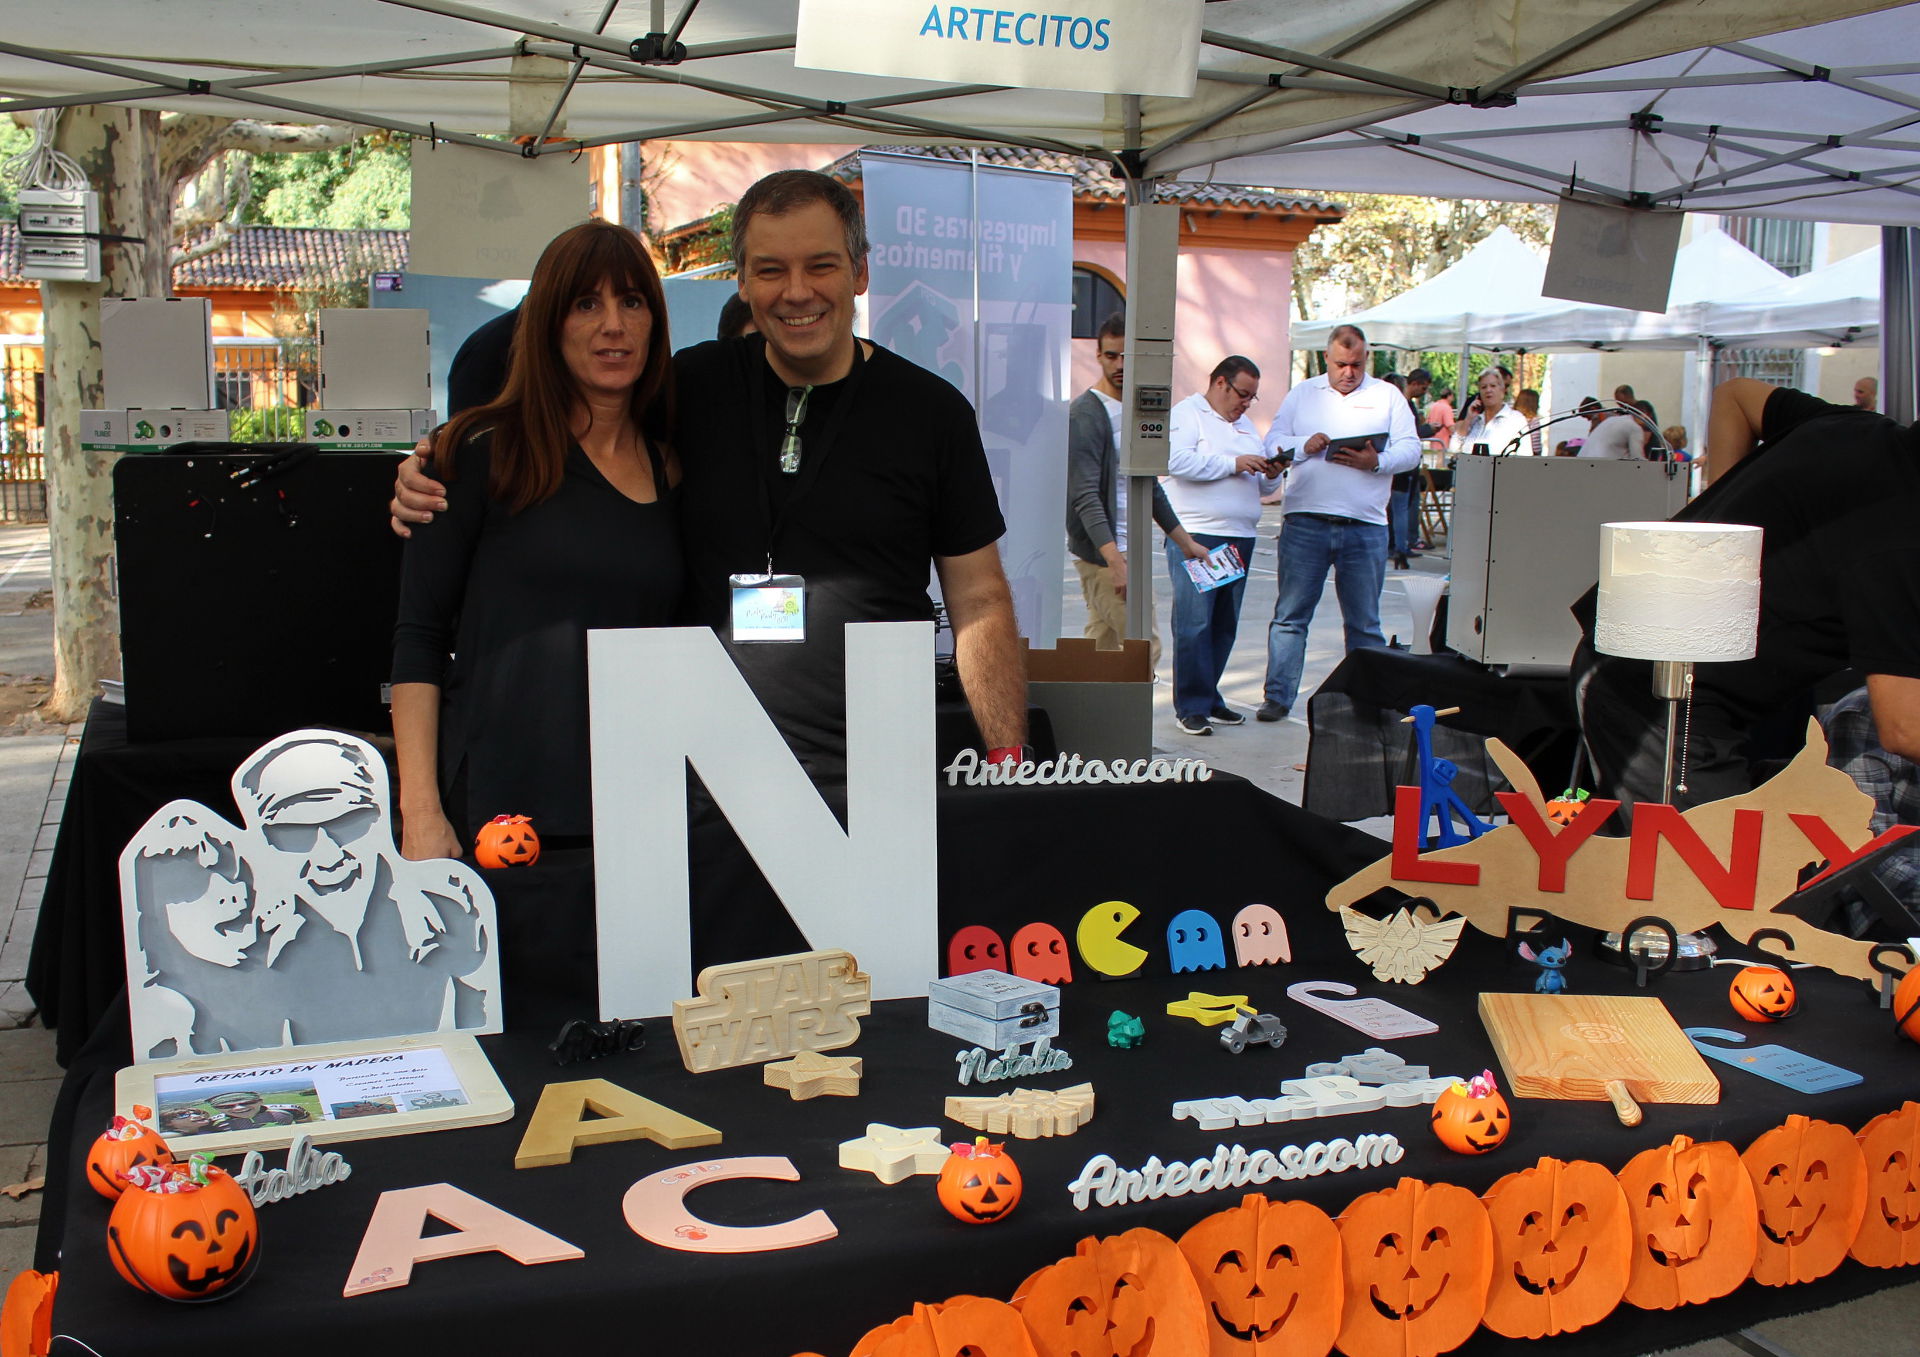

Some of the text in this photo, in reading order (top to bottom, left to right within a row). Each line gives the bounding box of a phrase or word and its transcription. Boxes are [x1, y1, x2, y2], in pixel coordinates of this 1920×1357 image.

[919, 4, 1112, 52] ARTECITOS
[587, 620, 939, 1022] N
[685, 956, 868, 1026] STAR
[194, 1054, 405, 1084] RETRATO EN MADERA
[685, 1000, 870, 1071] WARS
[956, 1035, 1073, 1086] Natalia
[515, 1078, 723, 1170] A
[233, 1134, 352, 1209] talia
[622, 1156, 839, 1253] C
[343, 1183, 585, 1297] A
